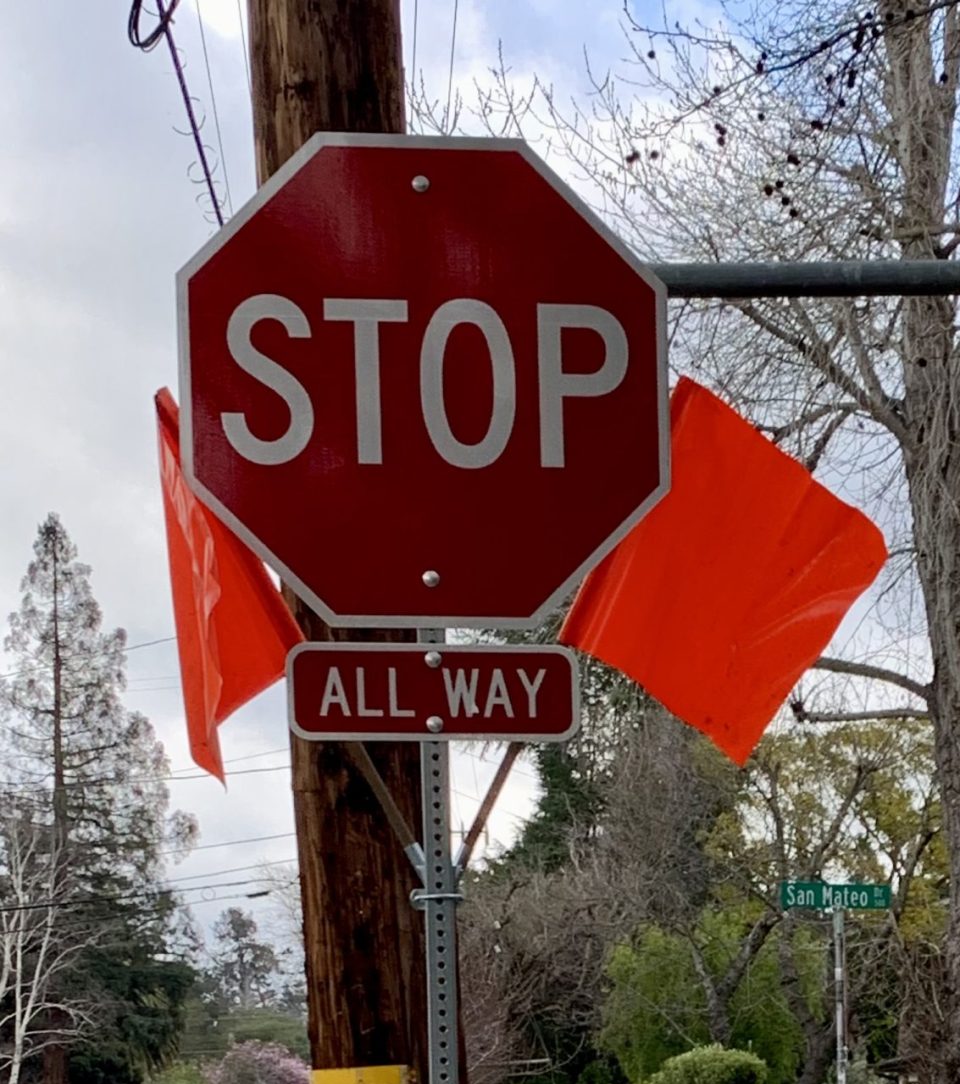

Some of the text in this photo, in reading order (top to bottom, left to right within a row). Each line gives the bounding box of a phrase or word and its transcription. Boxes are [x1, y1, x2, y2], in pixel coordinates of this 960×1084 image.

[220, 293, 629, 469] STOP
[319, 666, 547, 718] ALL WAY
[786, 885, 815, 905] San
[822, 886, 868, 906] Mateo
